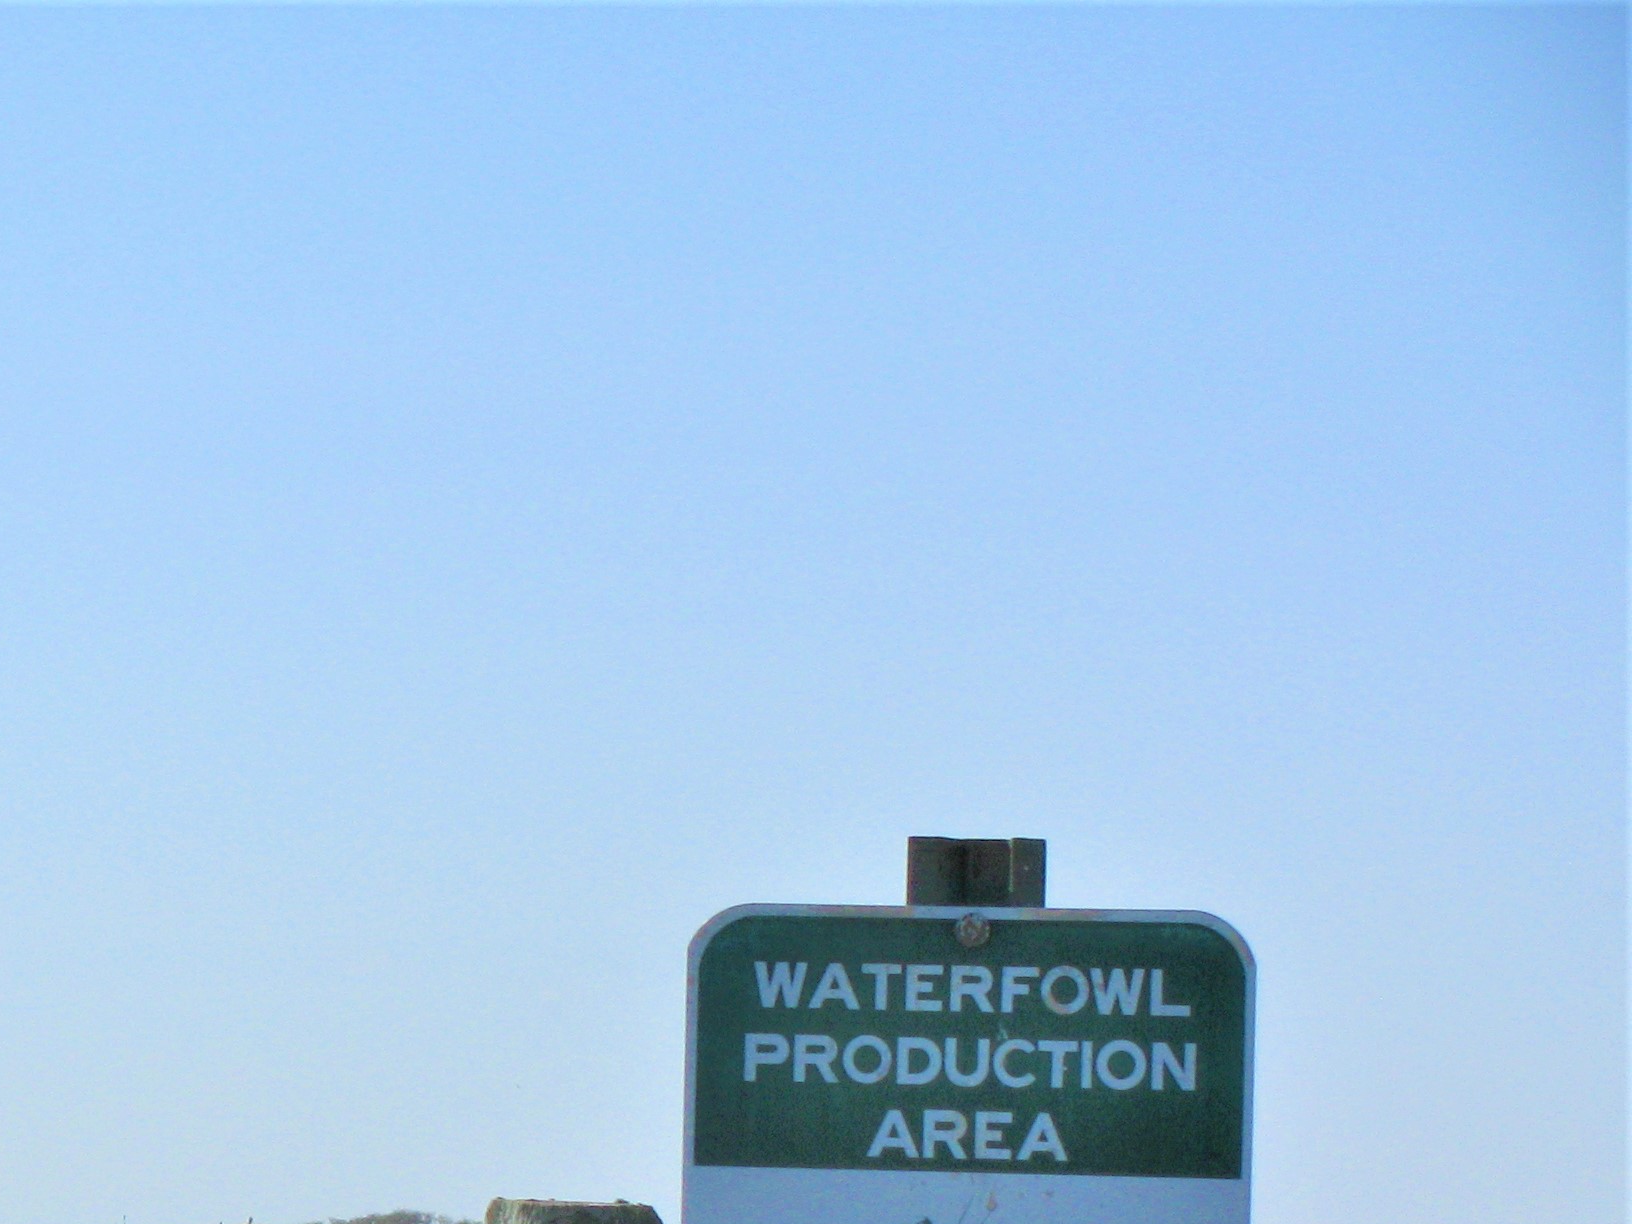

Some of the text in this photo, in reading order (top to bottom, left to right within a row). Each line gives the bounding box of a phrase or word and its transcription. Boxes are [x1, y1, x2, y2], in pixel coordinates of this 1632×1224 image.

[754, 960, 1192, 1018] WATERFOWL
[743, 1032, 1198, 1092] PRODUCTION
[867, 1108, 1068, 1162] AREA
